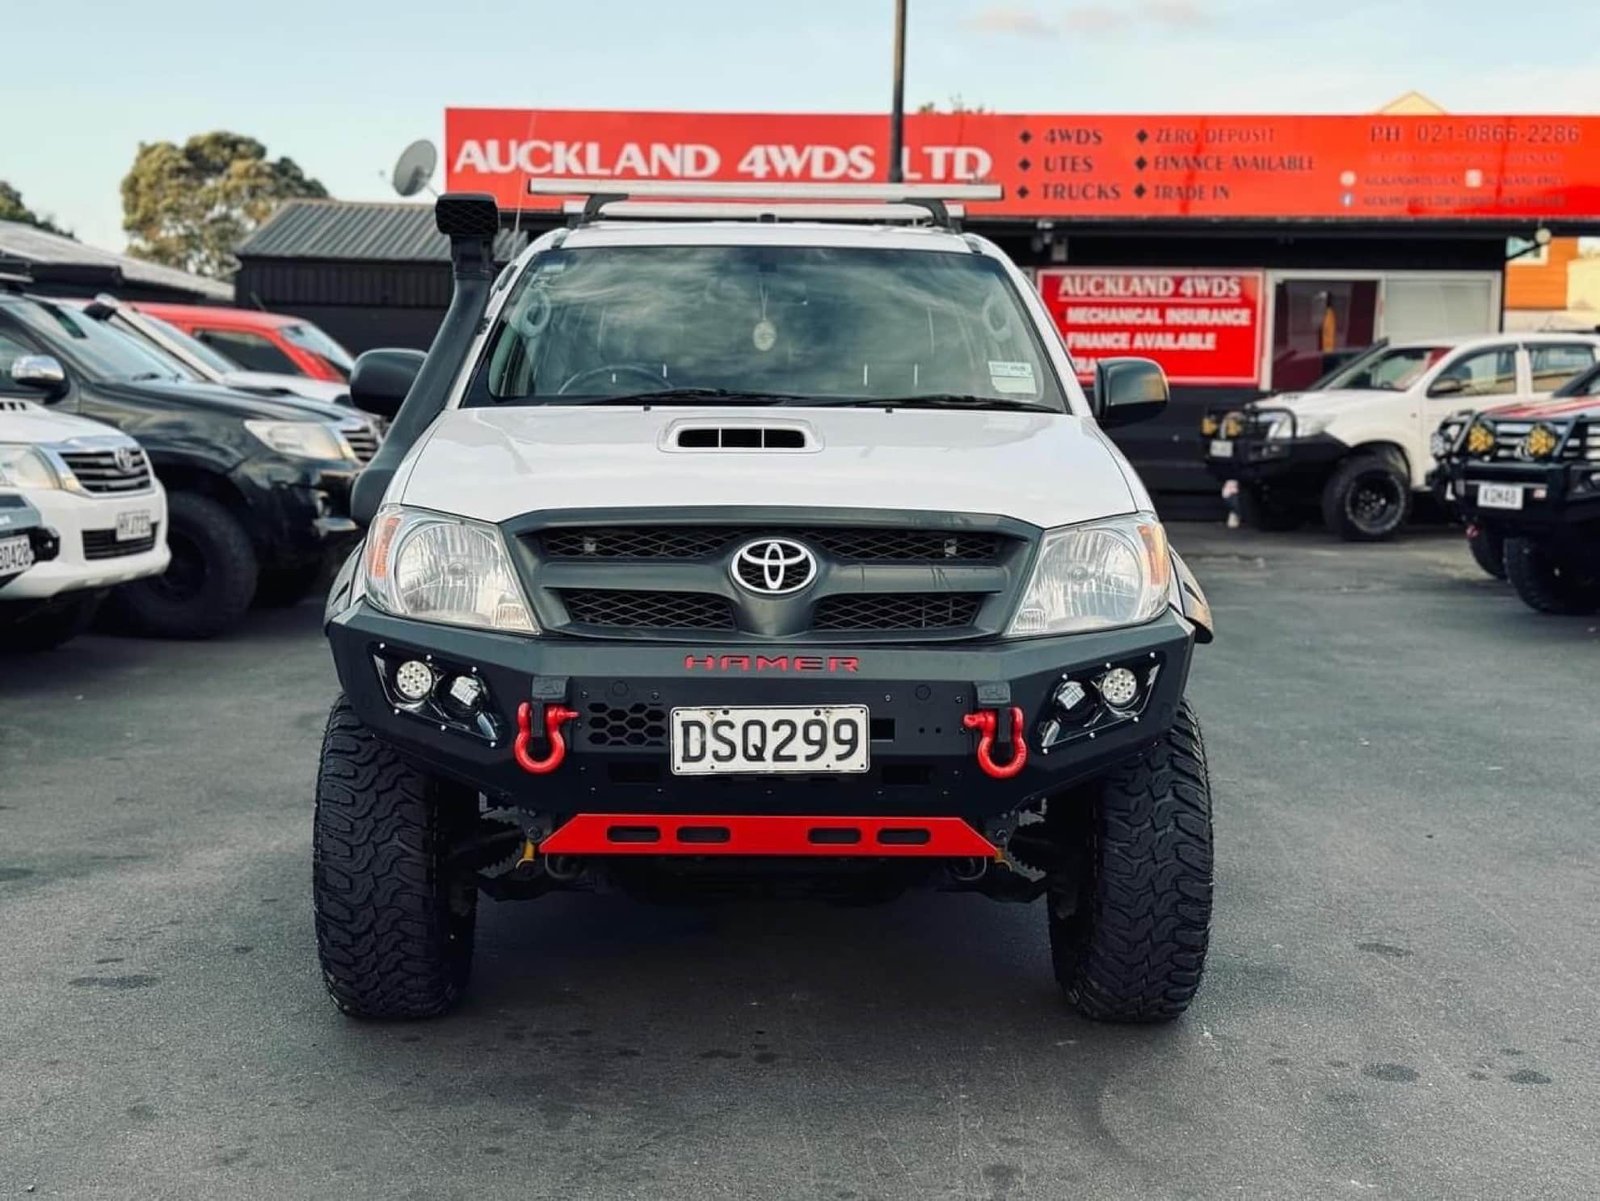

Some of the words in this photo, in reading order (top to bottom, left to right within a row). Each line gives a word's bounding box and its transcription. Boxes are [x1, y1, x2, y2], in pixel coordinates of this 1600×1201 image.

[1043, 129, 1103, 145] 4WDS
[1154, 128, 1199, 143] ZERO
[1204, 128, 1275, 143] DEPOSIT
[1370, 125, 1400, 143] PH
[453, 139, 720, 178] AUCKLAND
[737, 144, 876, 180] 4WDS
[901, 145, 993, 180] LTD
[1043, 156, 1094, 172] UTES
[1153, 155, 1225, 171] FINANCE
[1231, 156, 1316, 171] AVAILABLE
[1041, 183, 1122, 200] TRUCKS
[1154, 184, 1207, 200] TRADE
[1212, 184, 1230, 200] IN
[1059, 275, 1174, 297] AUCKLAND
[1179, 276, 1242, 298] 4WDS
[1066, 307, 1163, 325] MECHANICAL
[1164, 308, 1252, 326] INSURANCE
[1066, 332, 1132, 350] FINANCE
[1132, 333, 1217, 350] AVAILABLE
[684, 655, 860, 672] HAMER
[680, 718, 860, 763] DSQ299
